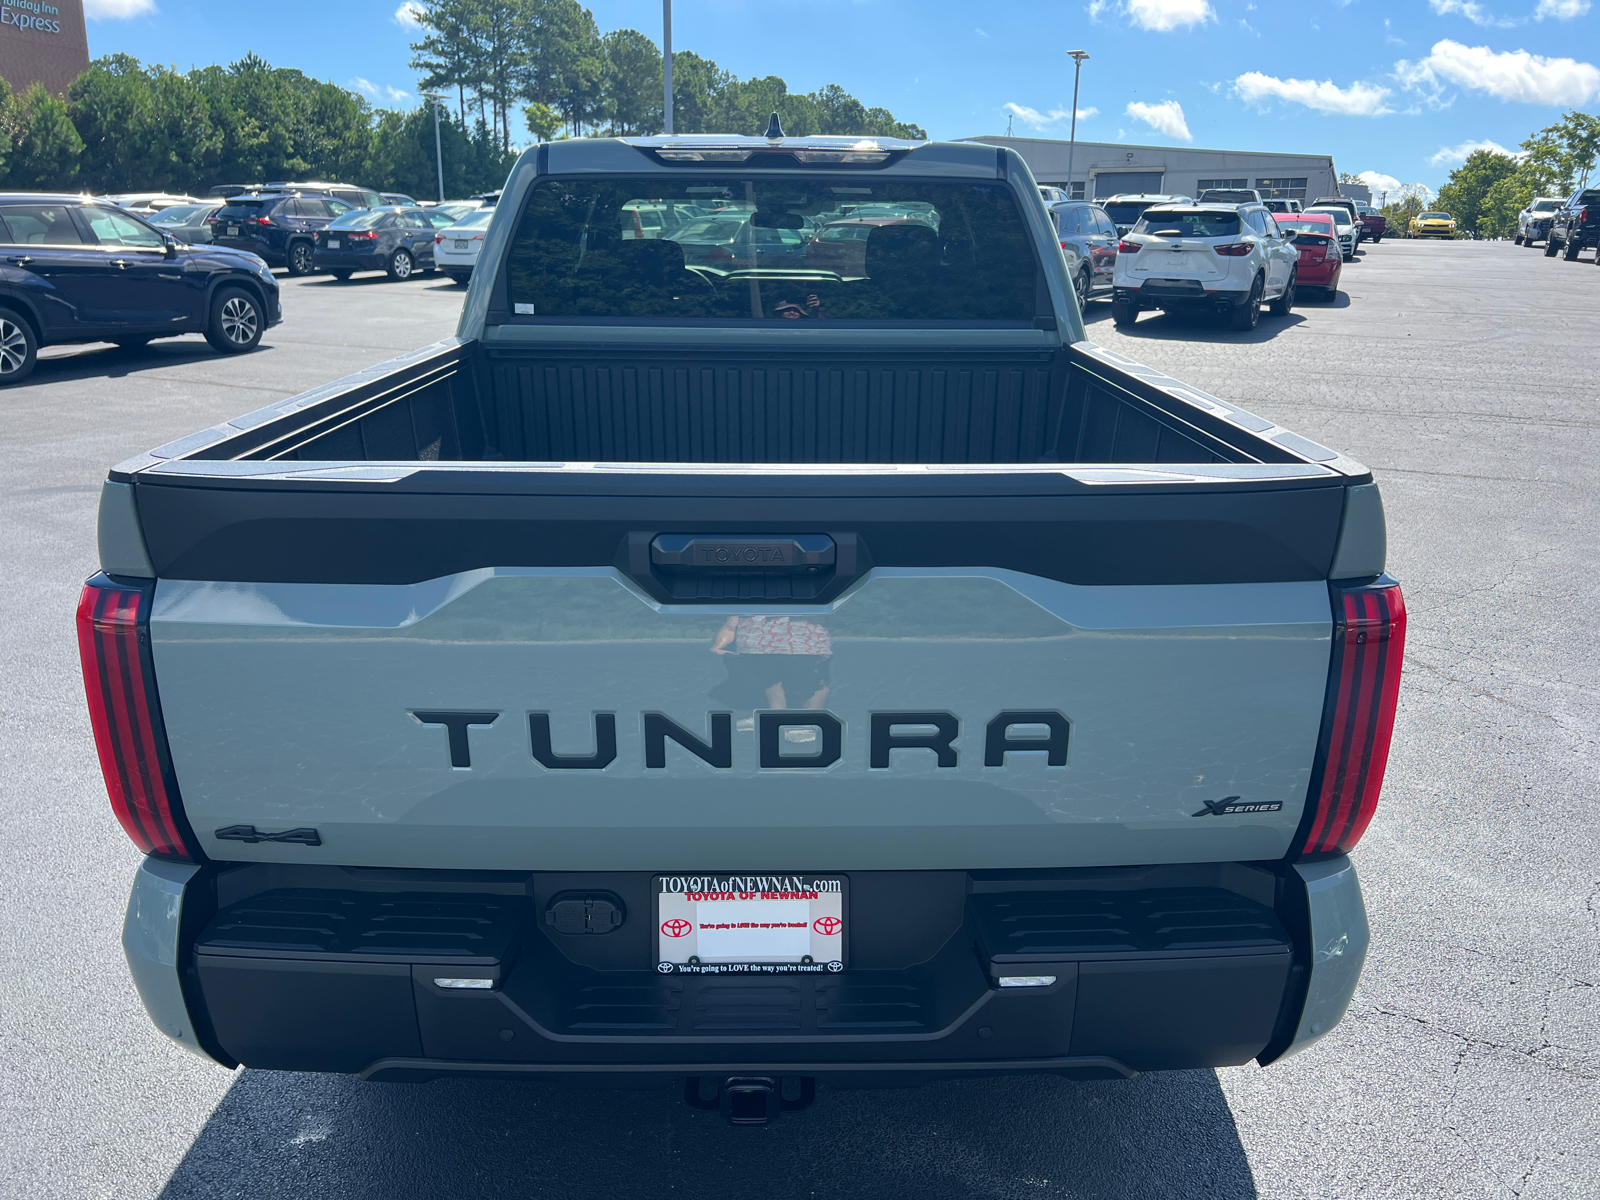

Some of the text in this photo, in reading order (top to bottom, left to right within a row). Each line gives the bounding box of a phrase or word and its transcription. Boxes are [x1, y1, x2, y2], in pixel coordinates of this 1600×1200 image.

[3, 0, 59, 15] oliday Inn
[0, 6, 60, 33] Express
[702, 547, 784, 563] TOYOTA
[406, 709, 1073, 771] TUNDRA
[1191, 796, 1280, 817] X SERIES
[685, 891, 818, 901] TOYOTA OF NEWNAN
[701, 965, 719, 974] going
[728, 964, 749, 972] LOVE
[750, 964, 761, 972] the
[762, 965, 775, 973] way
[776, 964, 797, 973] you're
[797, 964, 824, 972] treated!
